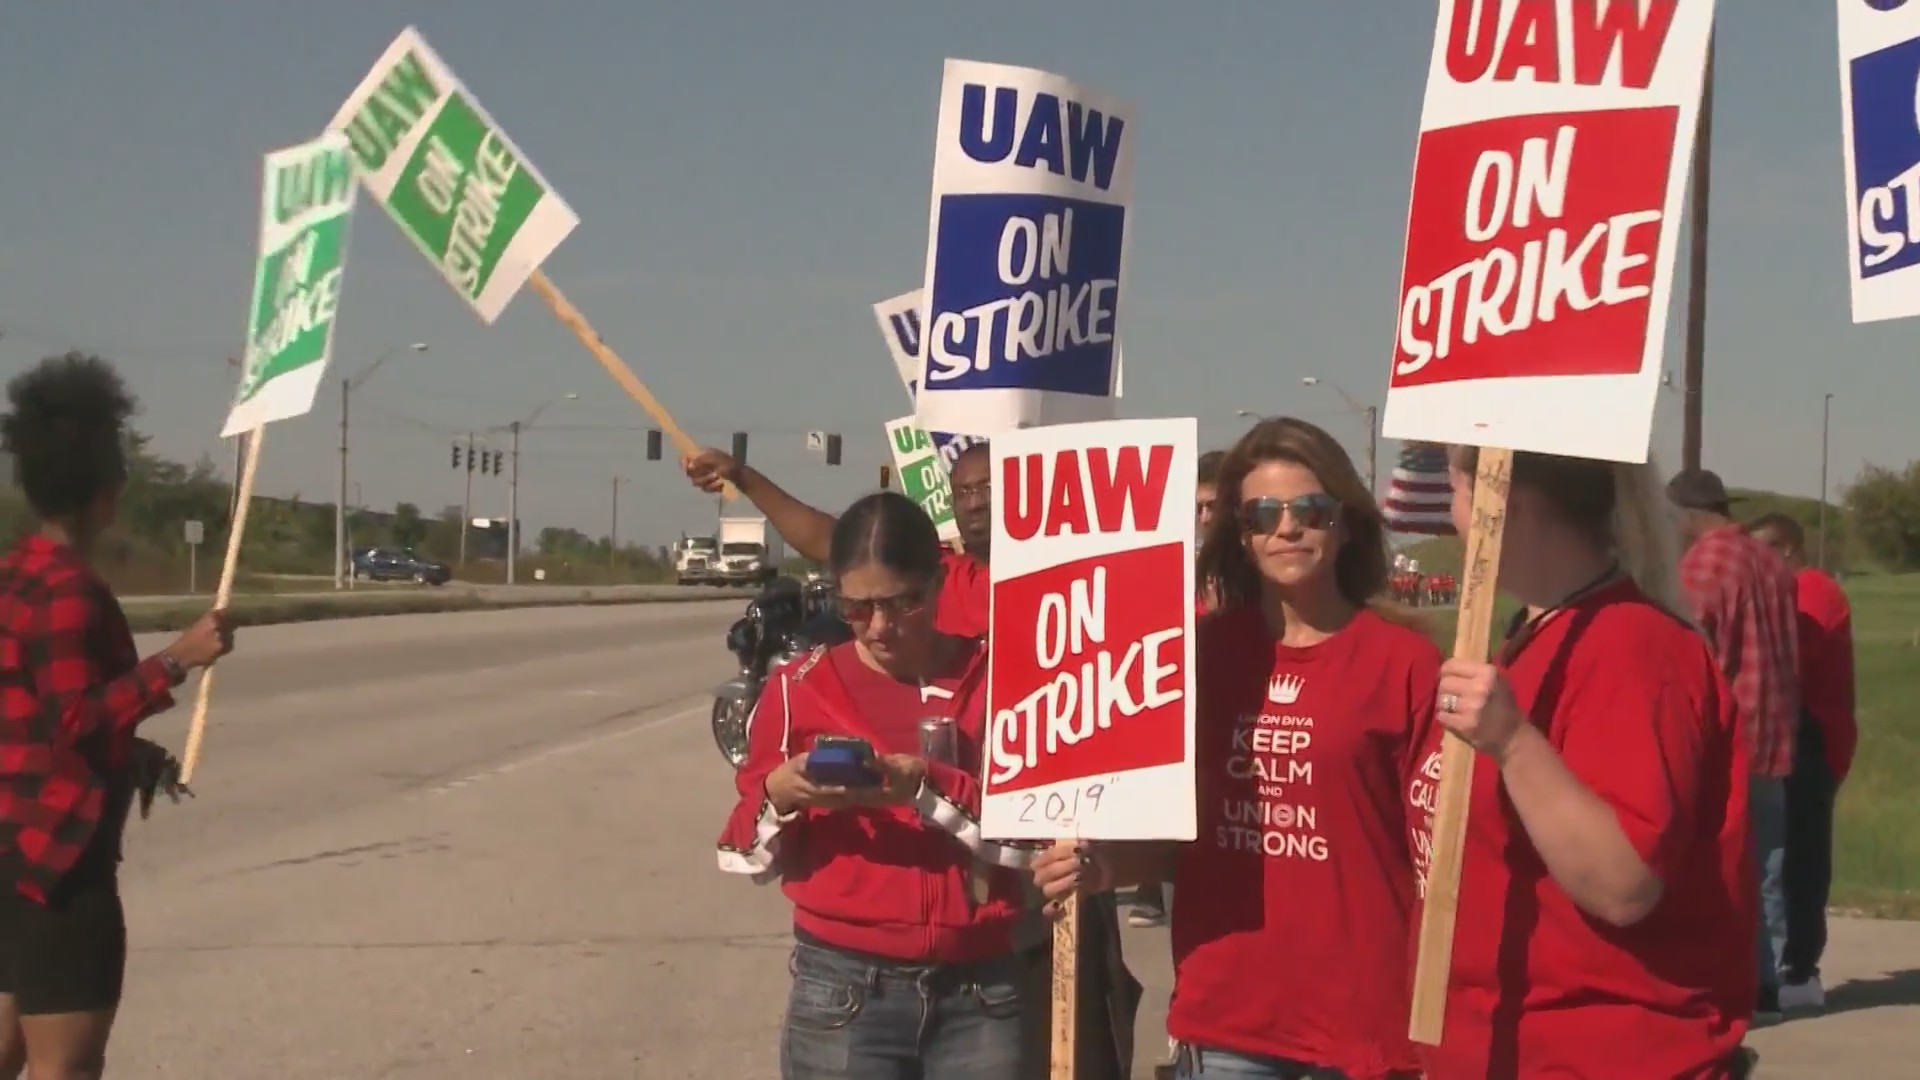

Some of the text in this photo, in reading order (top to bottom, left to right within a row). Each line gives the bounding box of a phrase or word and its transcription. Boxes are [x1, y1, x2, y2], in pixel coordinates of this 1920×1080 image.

[1446, 0, 1679, 89] UAW
[344, 48, 441, 172] UAW
[959, 83, 1124, 191] UAW
[417, 135, 464, 215] ON
[445, 128, 518, 295] STRIKE
[1465, 125, 1577, 242] ON
[997, 207, 1073, 285] ON
[929, 279, 1117, 381] STRIKE
[1397, 210, 1662, 375] STRIKE
[894, 426, 930, 453] UA
[1003, 445, 1174, 540] UAW
[1036, 566, 1106, 669] ON
[991, 627, 1183, 784] STRIKE
[1232, 728, 1311, 754] KEEP
[1282, 715, 1314, 727] DIVA
[1225, 799, 1316, 830] UNION
[1227, 756, 1312, 785] CALM
[1258, 785, 1283, 797] AND
[1217, 826, 1329, 861] STRONG
